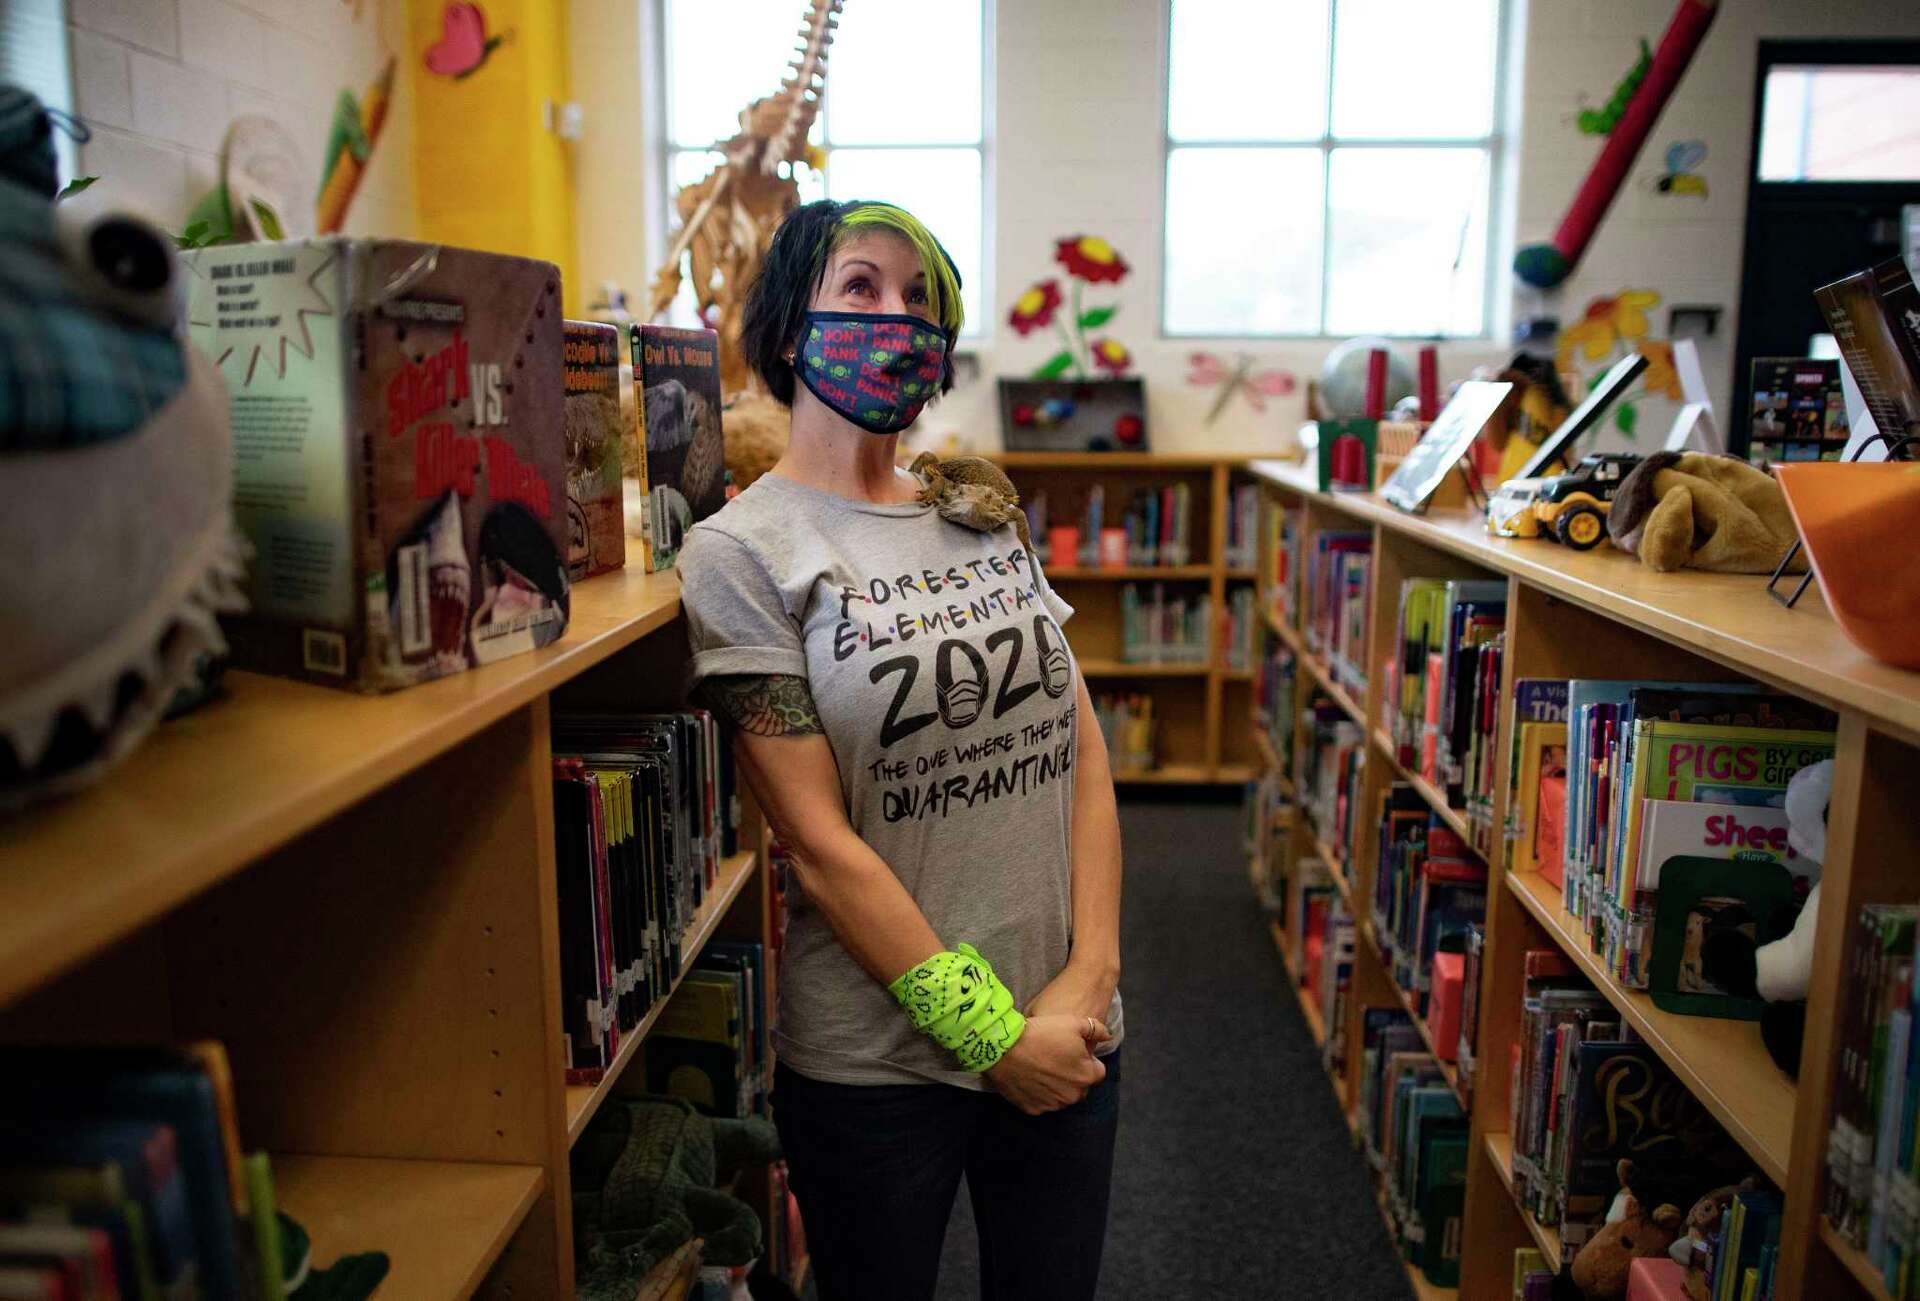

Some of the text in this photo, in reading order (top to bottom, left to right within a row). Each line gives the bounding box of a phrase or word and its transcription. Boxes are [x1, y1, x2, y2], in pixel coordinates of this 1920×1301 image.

[869, 614, 1071, 749] 2020
[868, 758, 910, 782] THE
[916, 749, 949, 776] ONE
[955, 732, 1015, 764] WHERE
[1021, 719, 1055, 747] THEY
[1667, 743, 1760, 782] PIGS
[1765, 748, 1792, 766] BY
